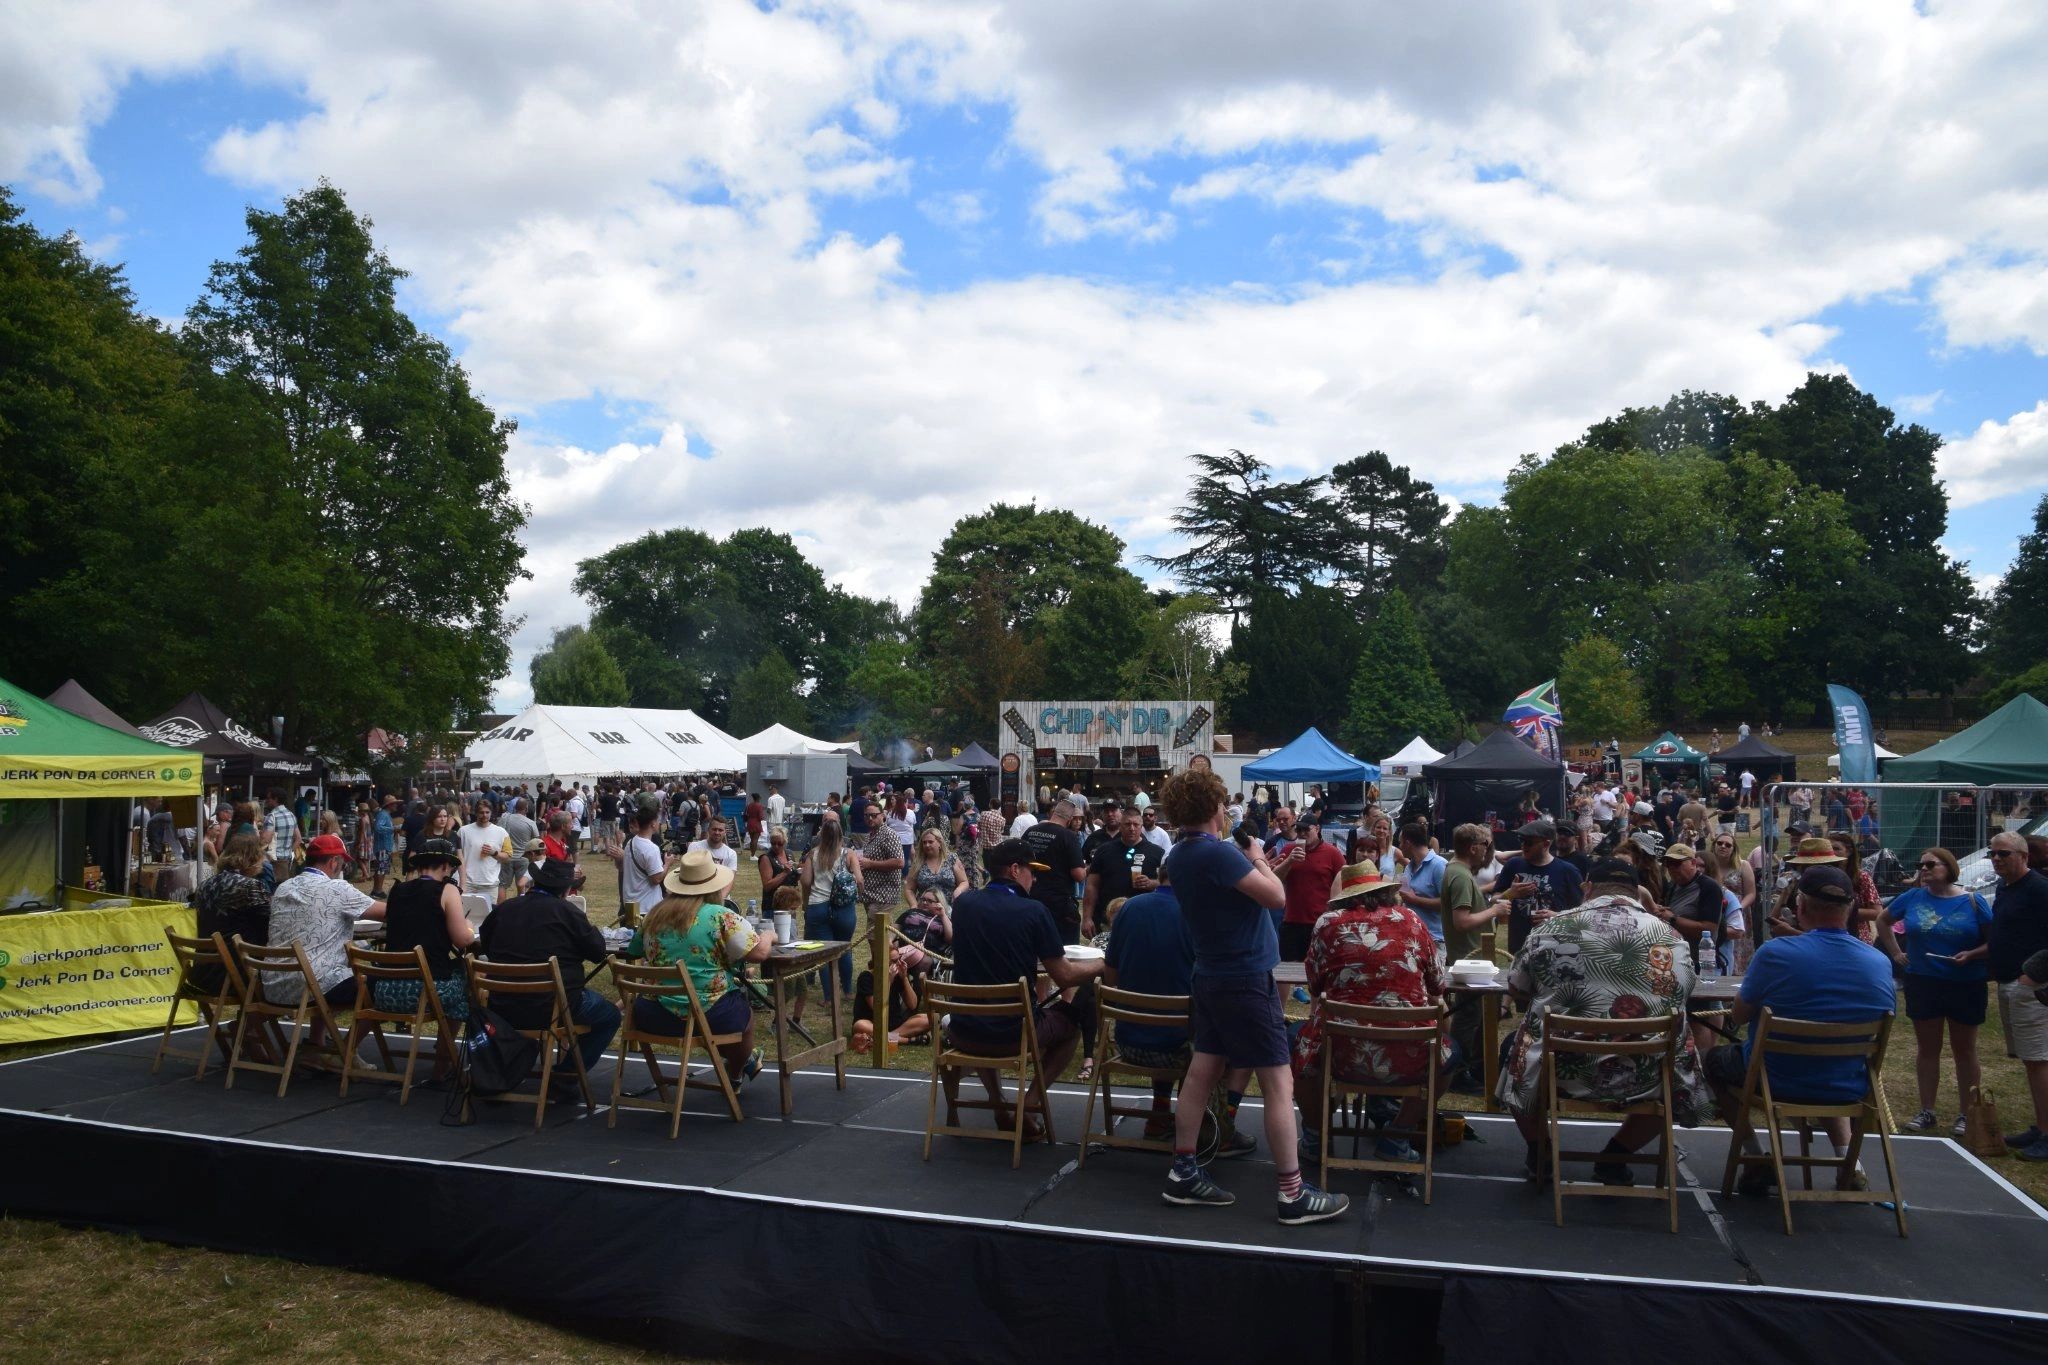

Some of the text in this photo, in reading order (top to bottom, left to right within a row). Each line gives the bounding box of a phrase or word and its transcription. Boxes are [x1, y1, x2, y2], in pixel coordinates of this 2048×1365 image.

[1040, 707, 1094, 734] CHIP
[1132, 707, 1170, 734] DIP
[154, 722, 212, 739] Chilli
[484, 726, 534, 742] BAR
[588, 731, 631, 745] BAR
[665, 731, 703, 745] BAR
[1579, 749, 1597, 757] BBQ
[1, 770, 155, 780] JERK PON DA CORNER
[21, 943, 163, 965] @jerkpondacorner
[16, 966, 174, 989] Jerk Pon Da Corner
